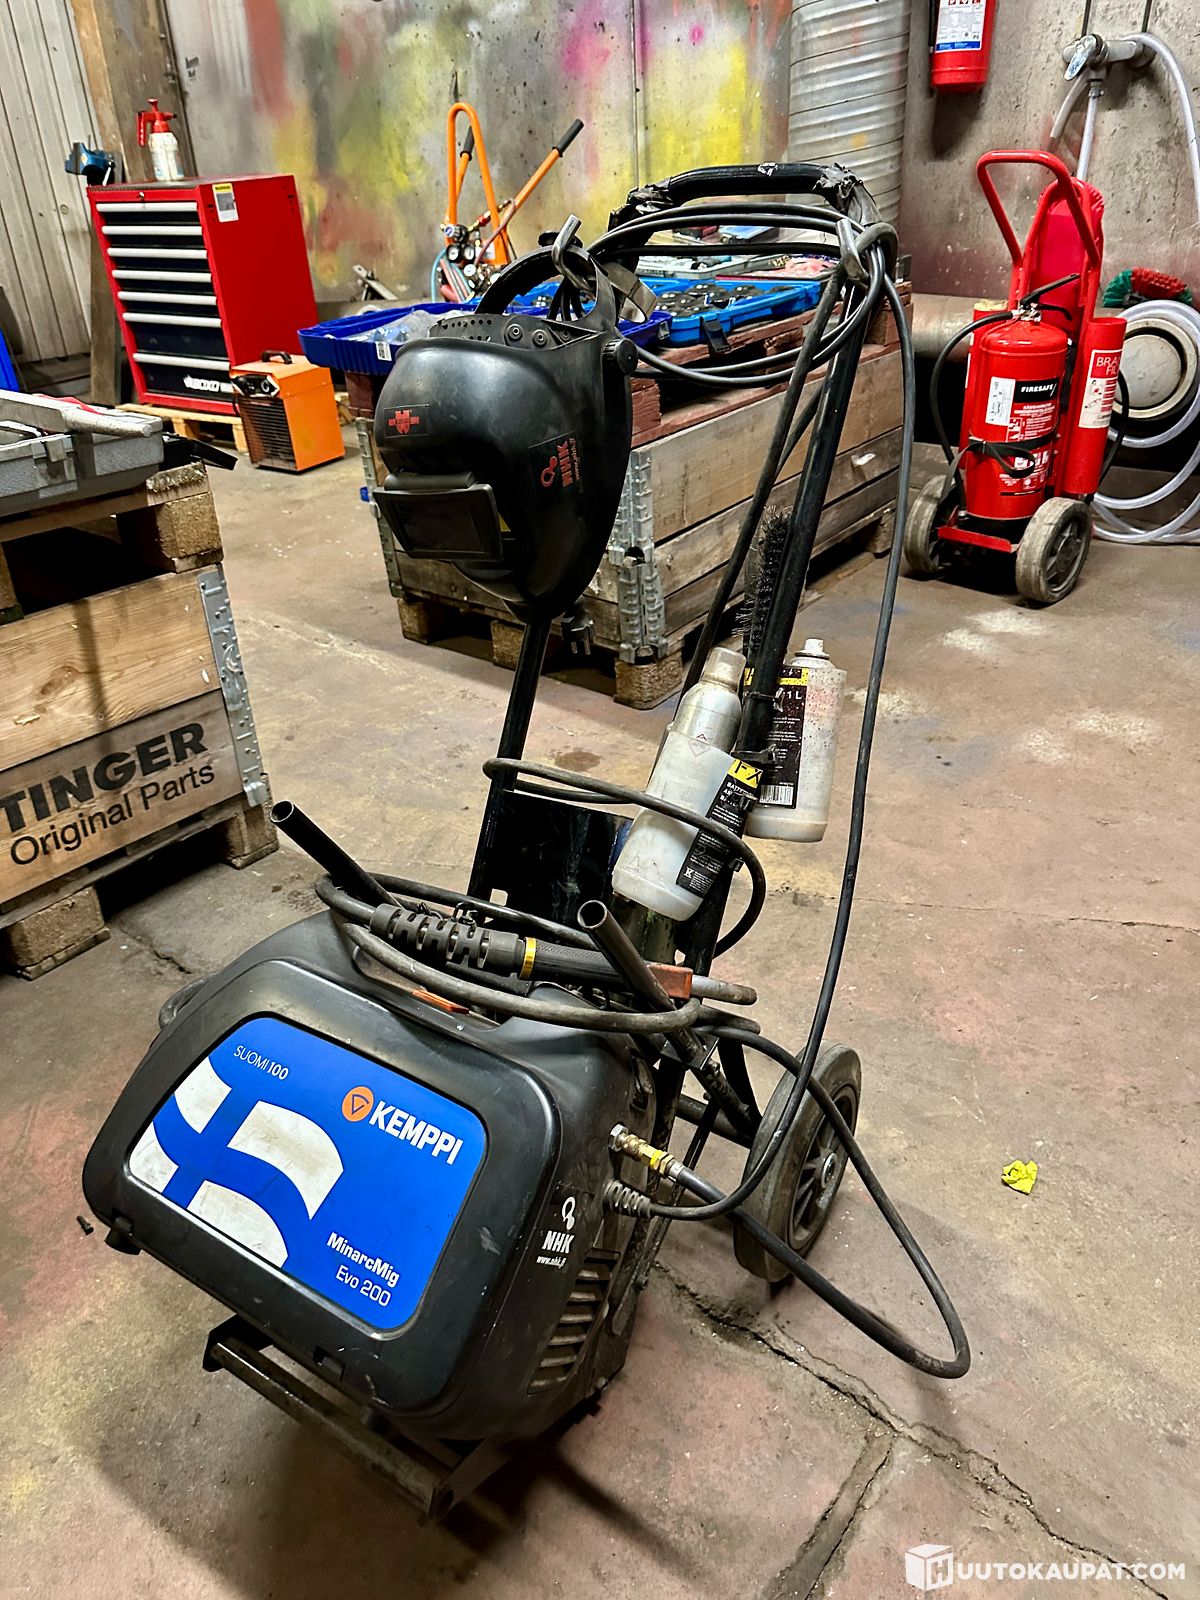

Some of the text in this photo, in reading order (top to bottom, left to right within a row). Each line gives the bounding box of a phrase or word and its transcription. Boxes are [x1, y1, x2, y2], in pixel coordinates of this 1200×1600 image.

[1096, 356, 1121, 367] BRA
[1020, 383, 1054, 393] FIRESAFE
[557, 441, 573, 487] NHK
[0, 722, 208, 834] TINGER
[10, 765, 216, 866] Original Parts
[233, 1045, 289, 1080] SUOMI 100
[369, 1100, 464, 1165] KEMPPI
[326, 1232, 401, 1288] MinarcMig
[542, 1231, 575, 1254] NHK
[335, 1264, 392, 1307] Evo 200
